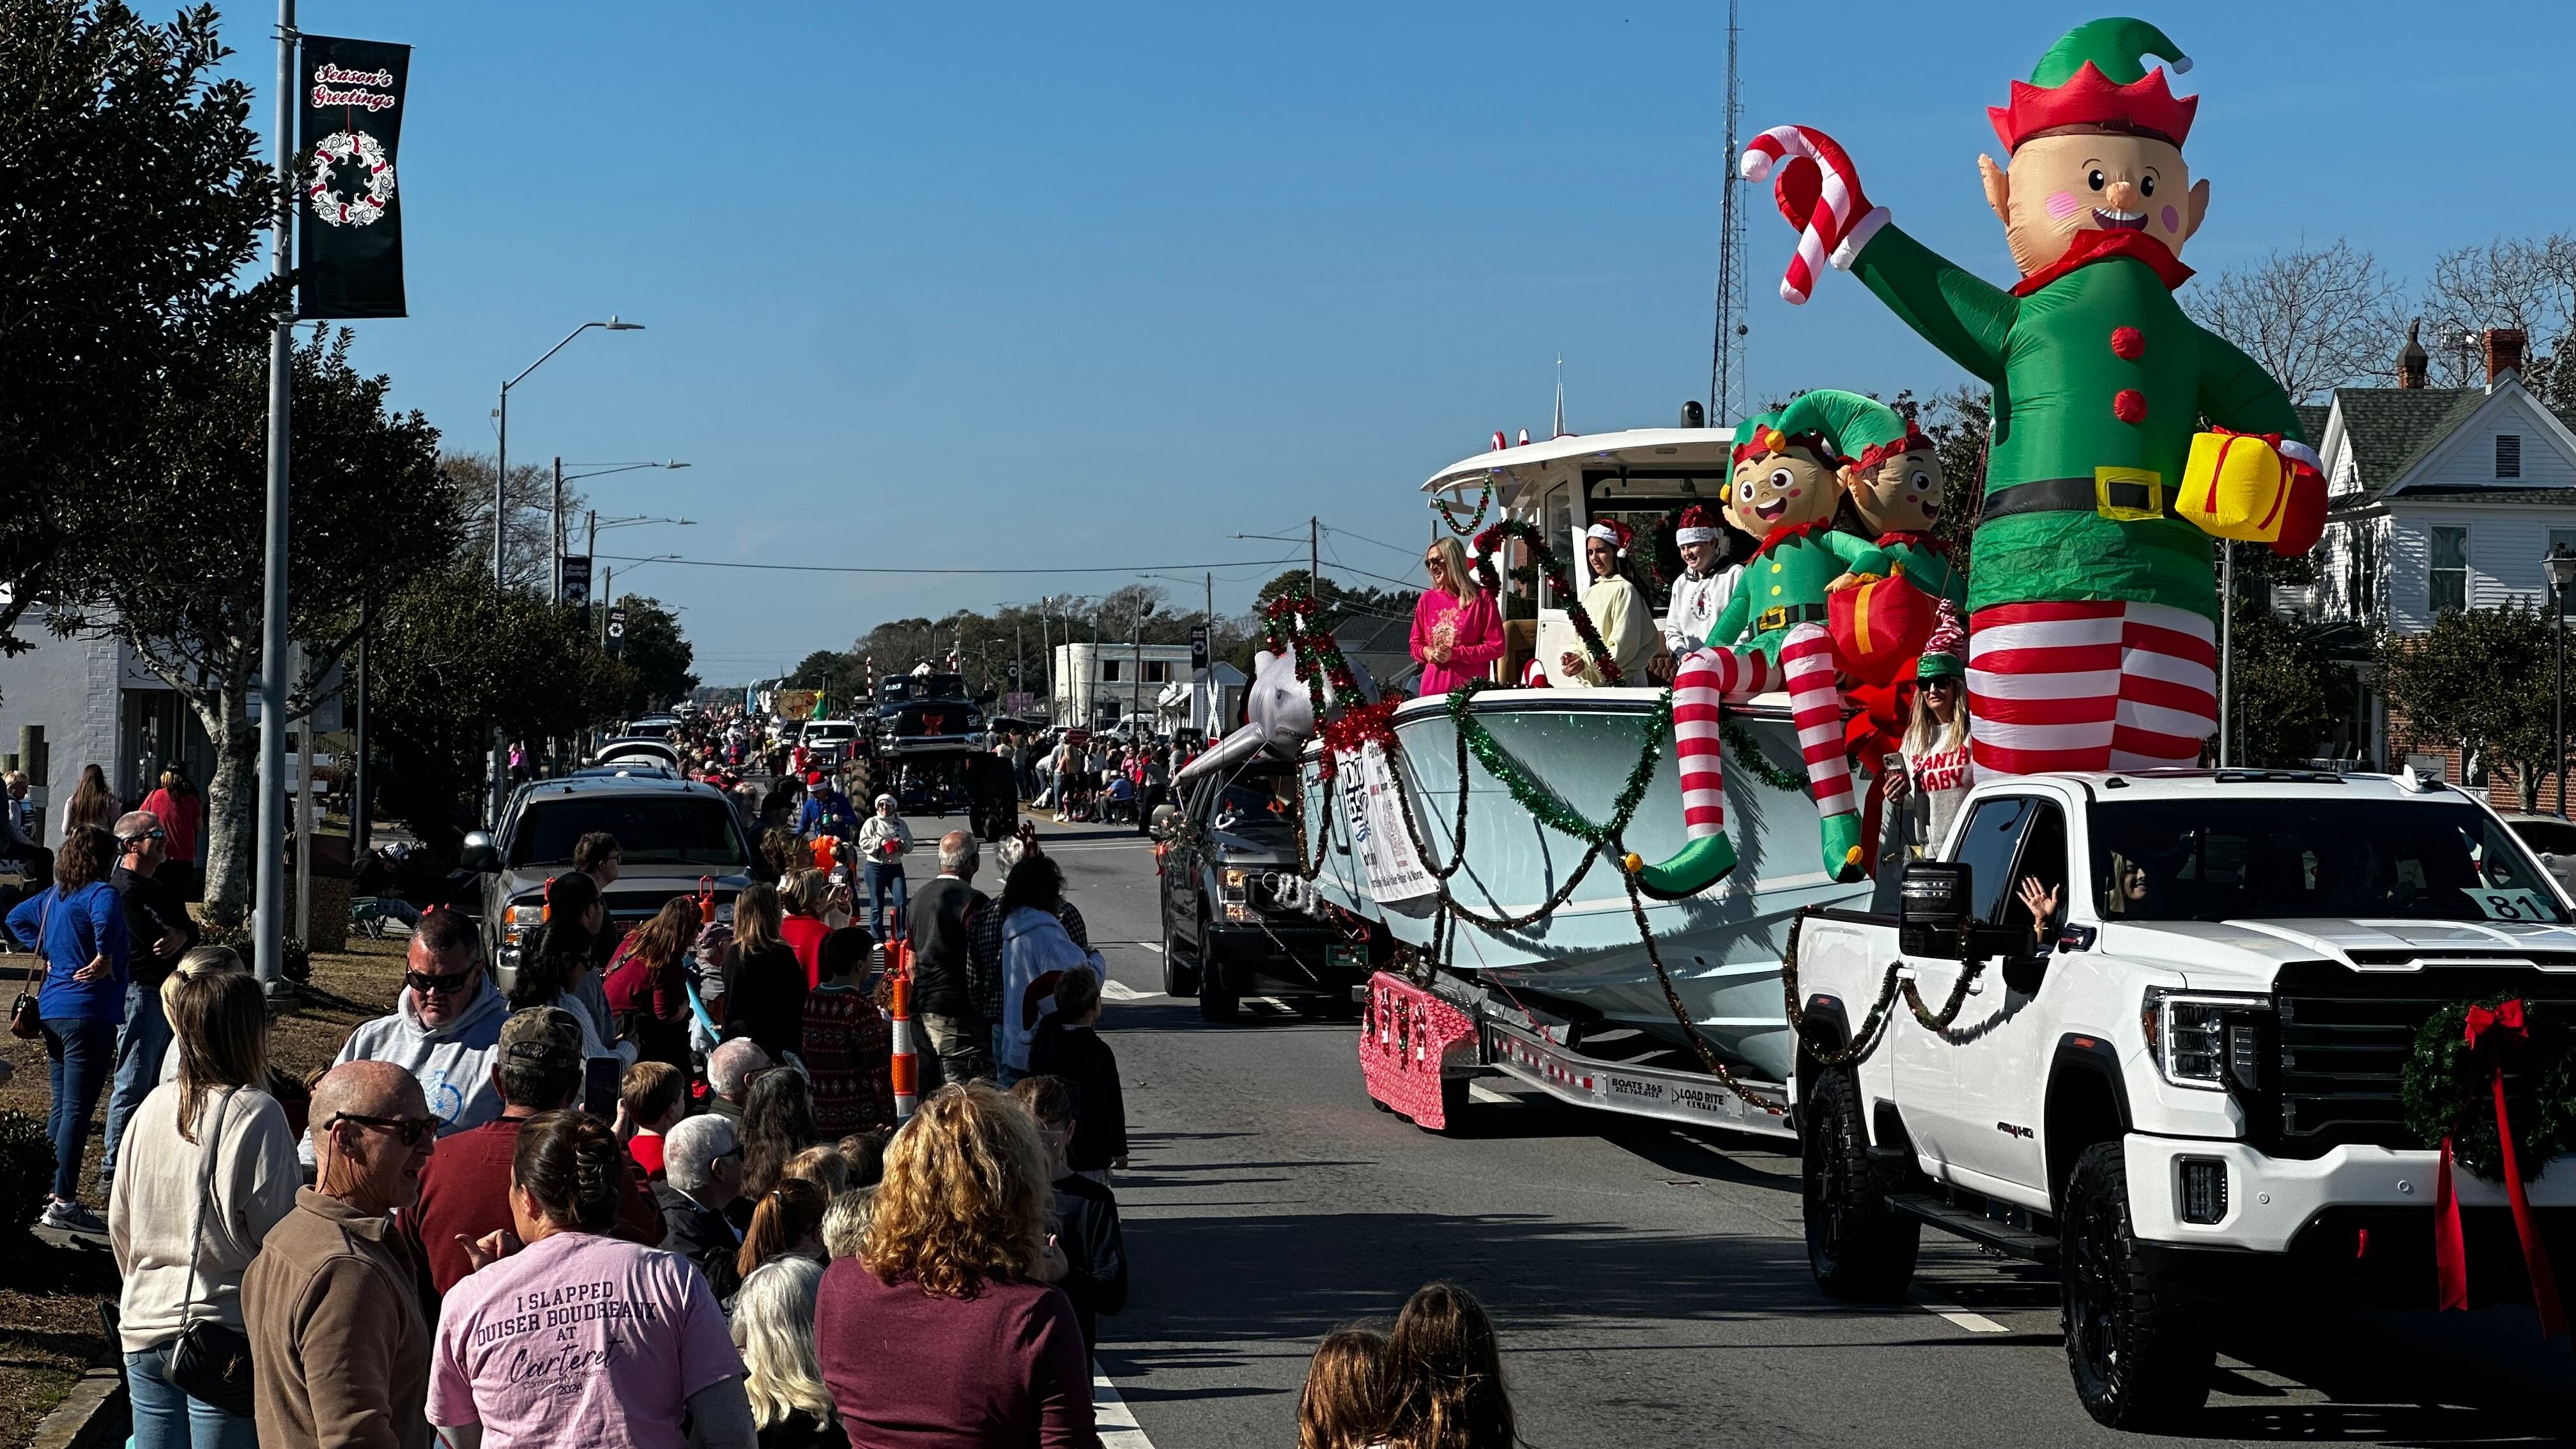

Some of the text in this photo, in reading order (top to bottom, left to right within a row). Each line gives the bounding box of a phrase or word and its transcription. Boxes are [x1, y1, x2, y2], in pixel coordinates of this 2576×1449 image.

[315, 63, 392, 87] Season's
[311, 84, 395, 112] Greetings
[1912, 746, 1970, 774] SANTA
[2487, 896, 2545, 919] 81
[1612, 1078, 1663, 1093] BOATS 365
[1680, 1088, 1724, 1105] LOAD RITE
[518, 1281, 613, 1313] I SLAPPED
[547, 1300, 657, 1328] BOUDREAUX
[556, 1326, 577, 1342] AT
[511, 1338, 625, 1383] Carteret
[523, 1375, 572, 1390] Community
